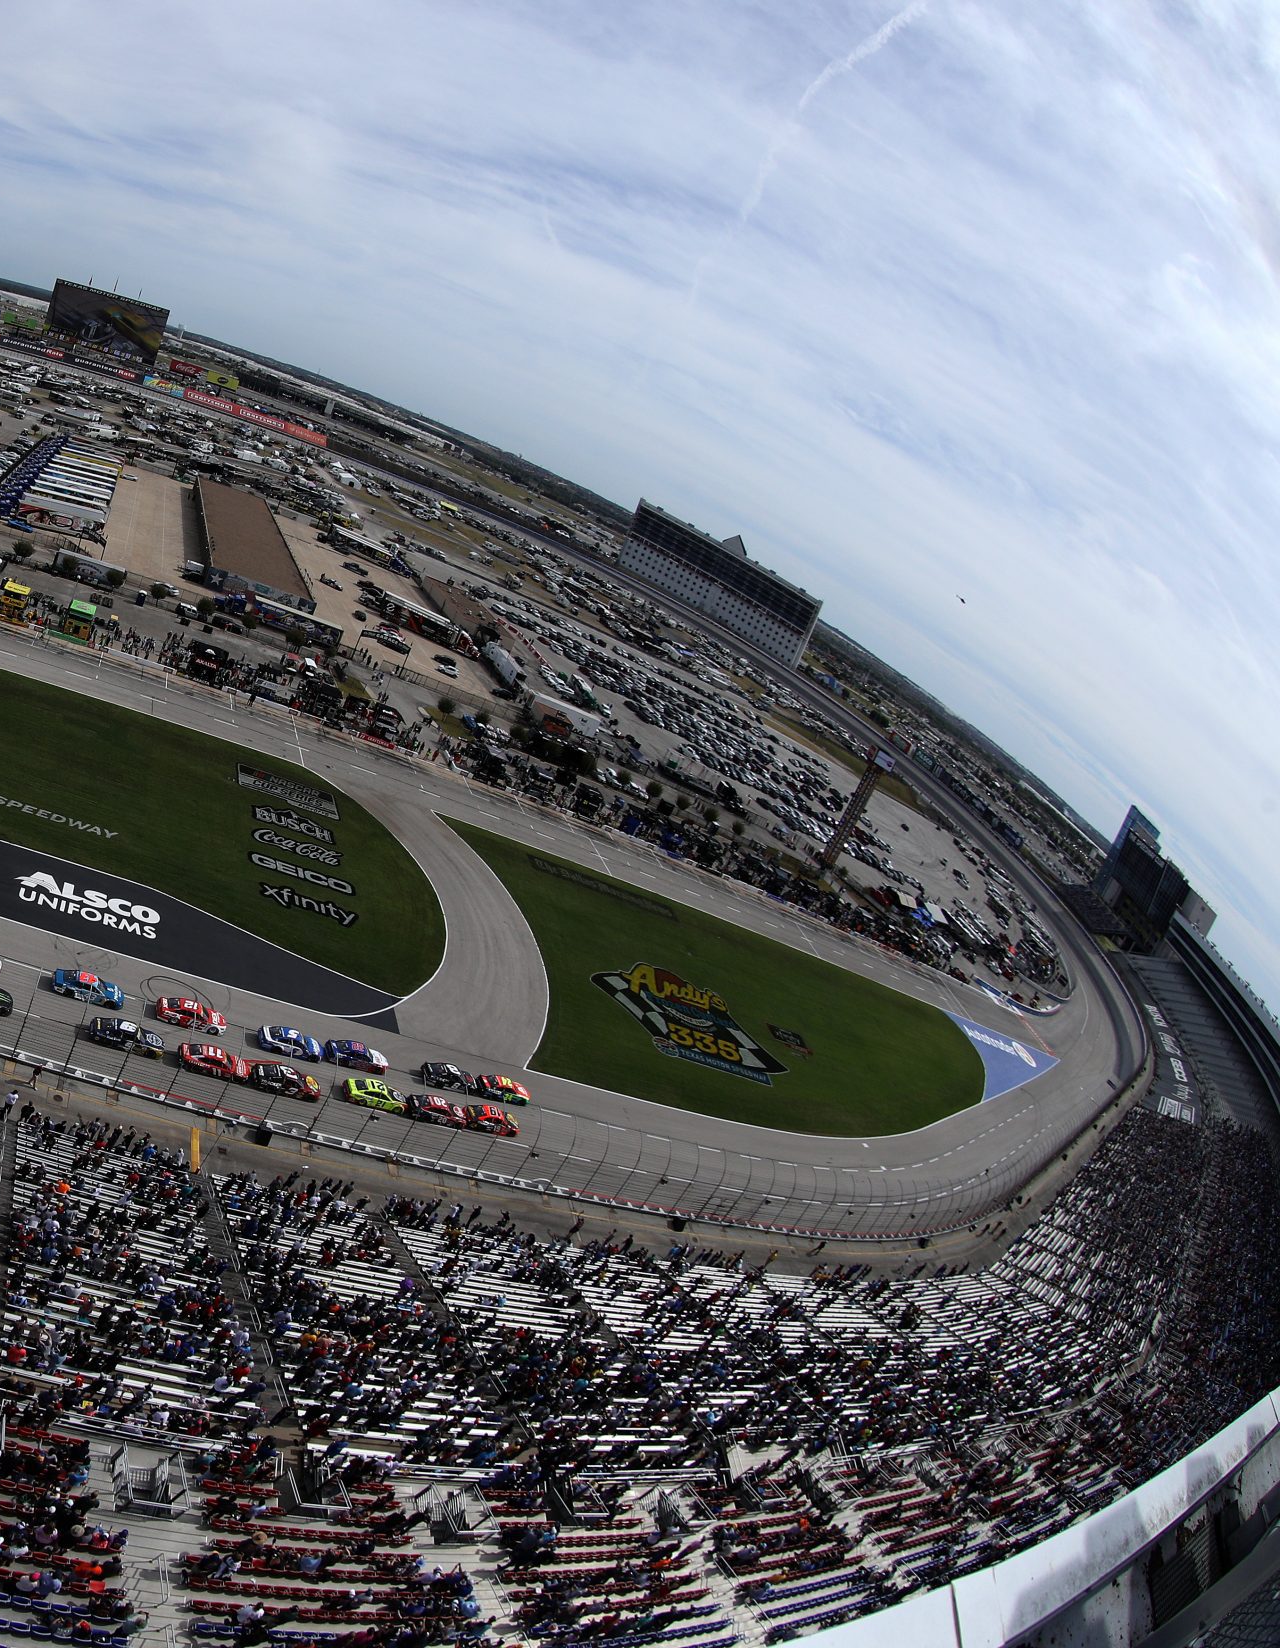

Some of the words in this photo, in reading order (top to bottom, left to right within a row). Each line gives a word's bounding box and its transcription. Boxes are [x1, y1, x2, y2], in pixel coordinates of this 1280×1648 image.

[64, 282, 88, 291] TEXAS
[89, 287, 118, 299] MOTOR
[120, 297, 161, 311] SPEEDWAY
[271, 776, 320, 796] NASCAR
[255, 808, 333, 843] BUSCH
[253, 829, 342, 866] Coca-Cola
[251, 853, 353, 894] GEICO
[15, 871, 161, 925] ALSCO
[263, 884, 355, 926] xfinity
[18, 888, 158, 940] UNIFORMS
[620, 964, 728, 1012] Andy's
[184, 1000, 198, 1010] 12
[1144, 1003, 1168, 1028] BUSCH
[208, 1046, 223, 1058] 11
[667, 1022, 742, 1062] 335
[212, 1068, 221, 1077] 11
[681, 1049, 705, 1063] TEXAS
[706, 1056, 730, 1070] MOTOR
[730, 1063, 767, 1081] SPEEDWAY
[1170, 1057, 1187, 1083] GEICO
[370, 1080, 386, 1091] 21
[375, 1100, 384, 1108] 21
[433, 1097, 447, 1107] 20
[437, 1116, 447, 1124] 20
